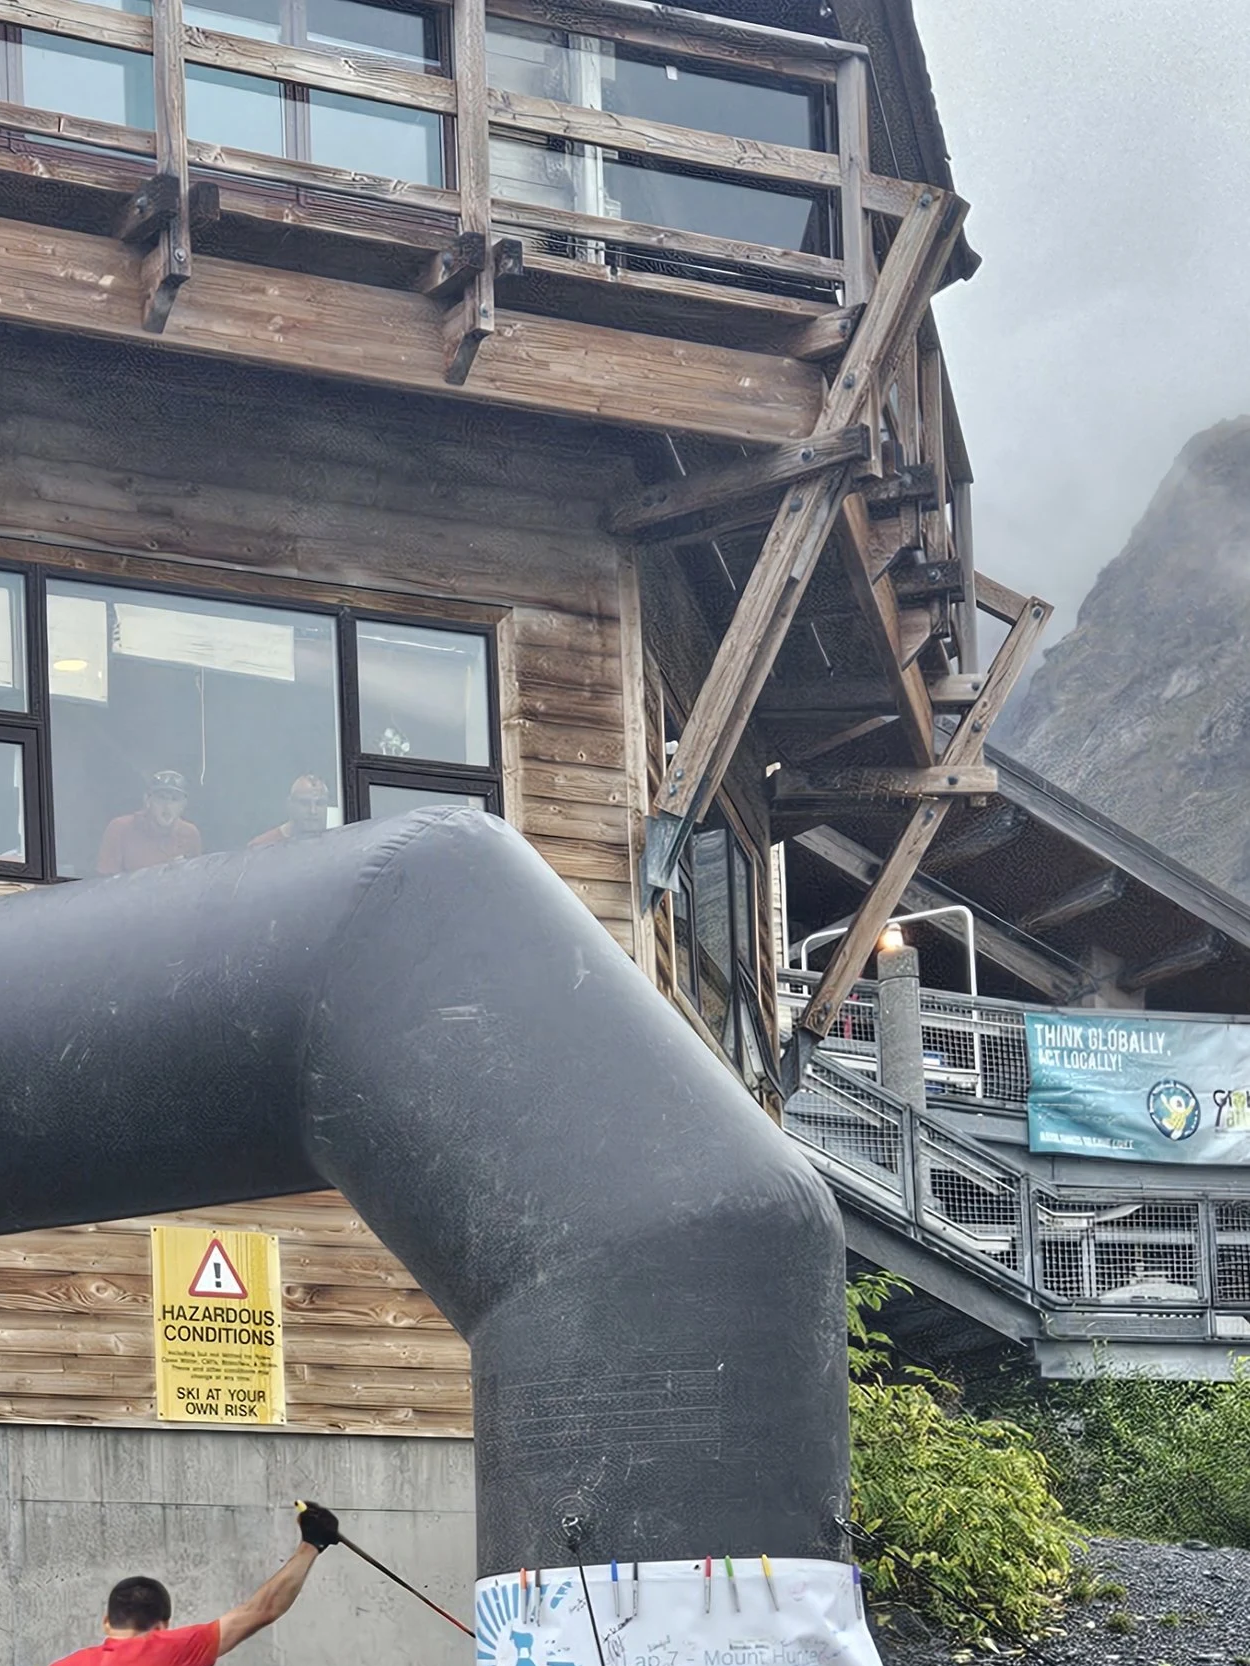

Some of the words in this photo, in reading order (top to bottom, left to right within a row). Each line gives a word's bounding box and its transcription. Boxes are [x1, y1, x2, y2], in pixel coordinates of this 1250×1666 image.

[1034, 1023, 1085, 1049] THINK
[1088, 1028, 1172, 1057] GLOBALLY,
[1038, 1049, 1061, 1066] ACT
[1063, 1051, 1123, 1073] LOCALLY!
[162, 1304, 275, 1327] HAZARDOUS
[164, 1325, 275, 1347] CONDITIONS
[177, 1387, 200, 1401] SKI
[206, 1388, 222, 1401] AT
[228, 1388, 266, 1403] YOUR
[185, 1402, 219, 1416] OWN
[225, 1404, 258, 1418] RISK
[667, 1650, 679, 1666] 7
[704, 1649, 767, 1666] Mount
